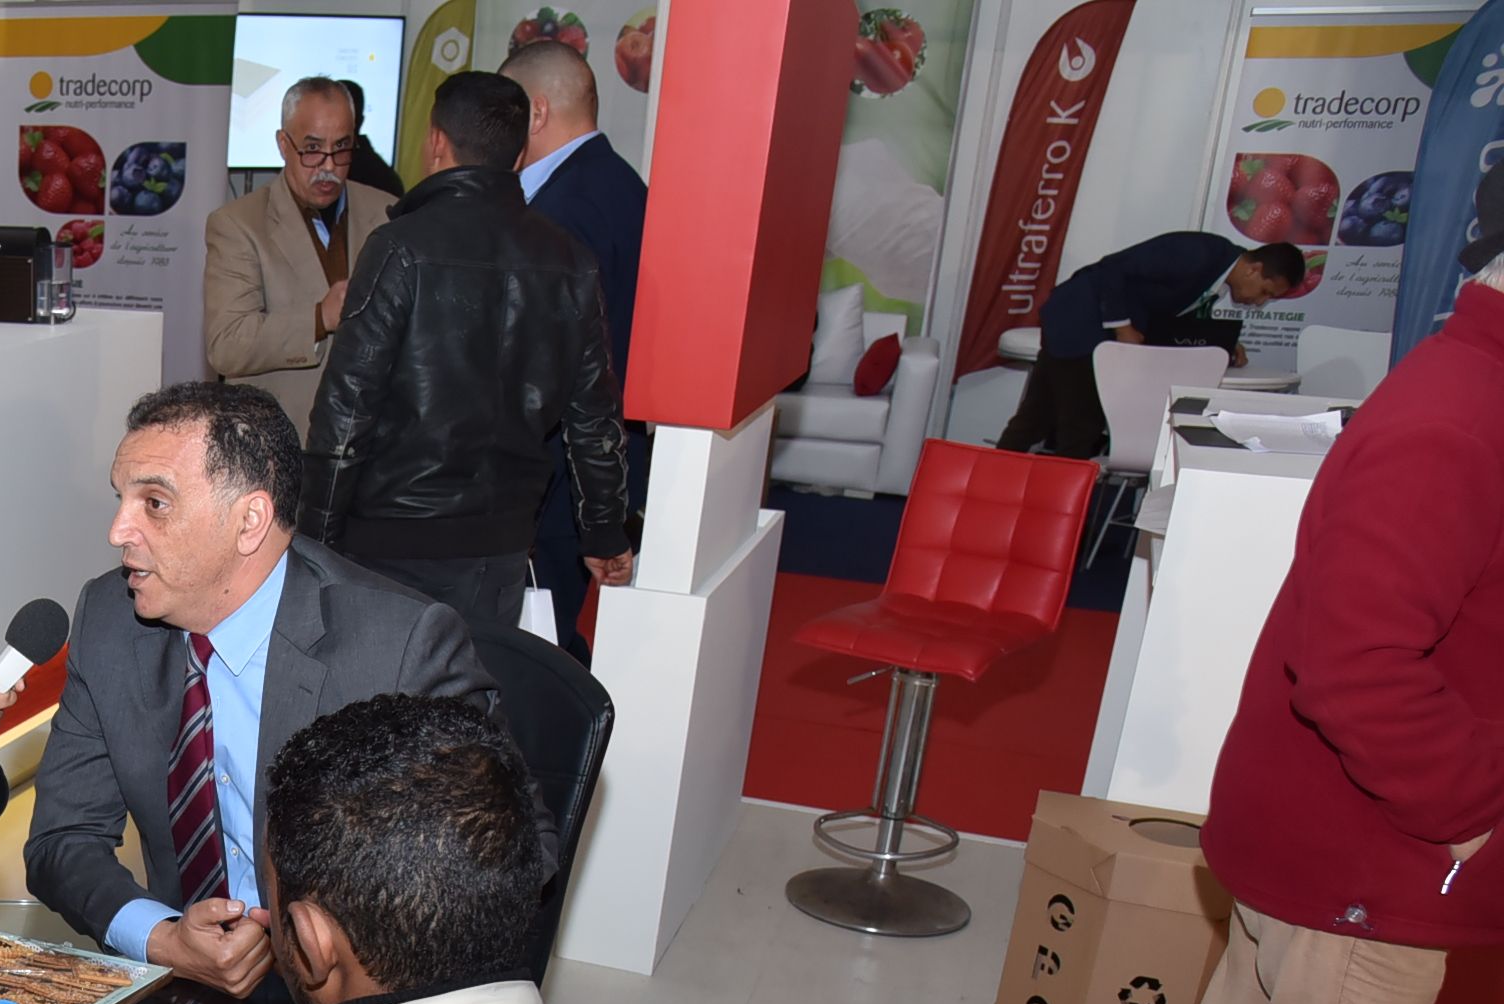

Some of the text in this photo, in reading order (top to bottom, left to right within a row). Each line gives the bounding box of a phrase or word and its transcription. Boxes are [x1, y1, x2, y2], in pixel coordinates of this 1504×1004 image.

[59, 73, 152, 102] tradecorp
[65, 100, 135, 110] nutri-performance
[1293, 90, 1420, 122] tradecorp
[1298, 118, 1394, 131] nutri-performance
[1002, 99, 1086, 315] ultraferro K
[1212, 308, 1306, 321] OTRE STRATEGIE
